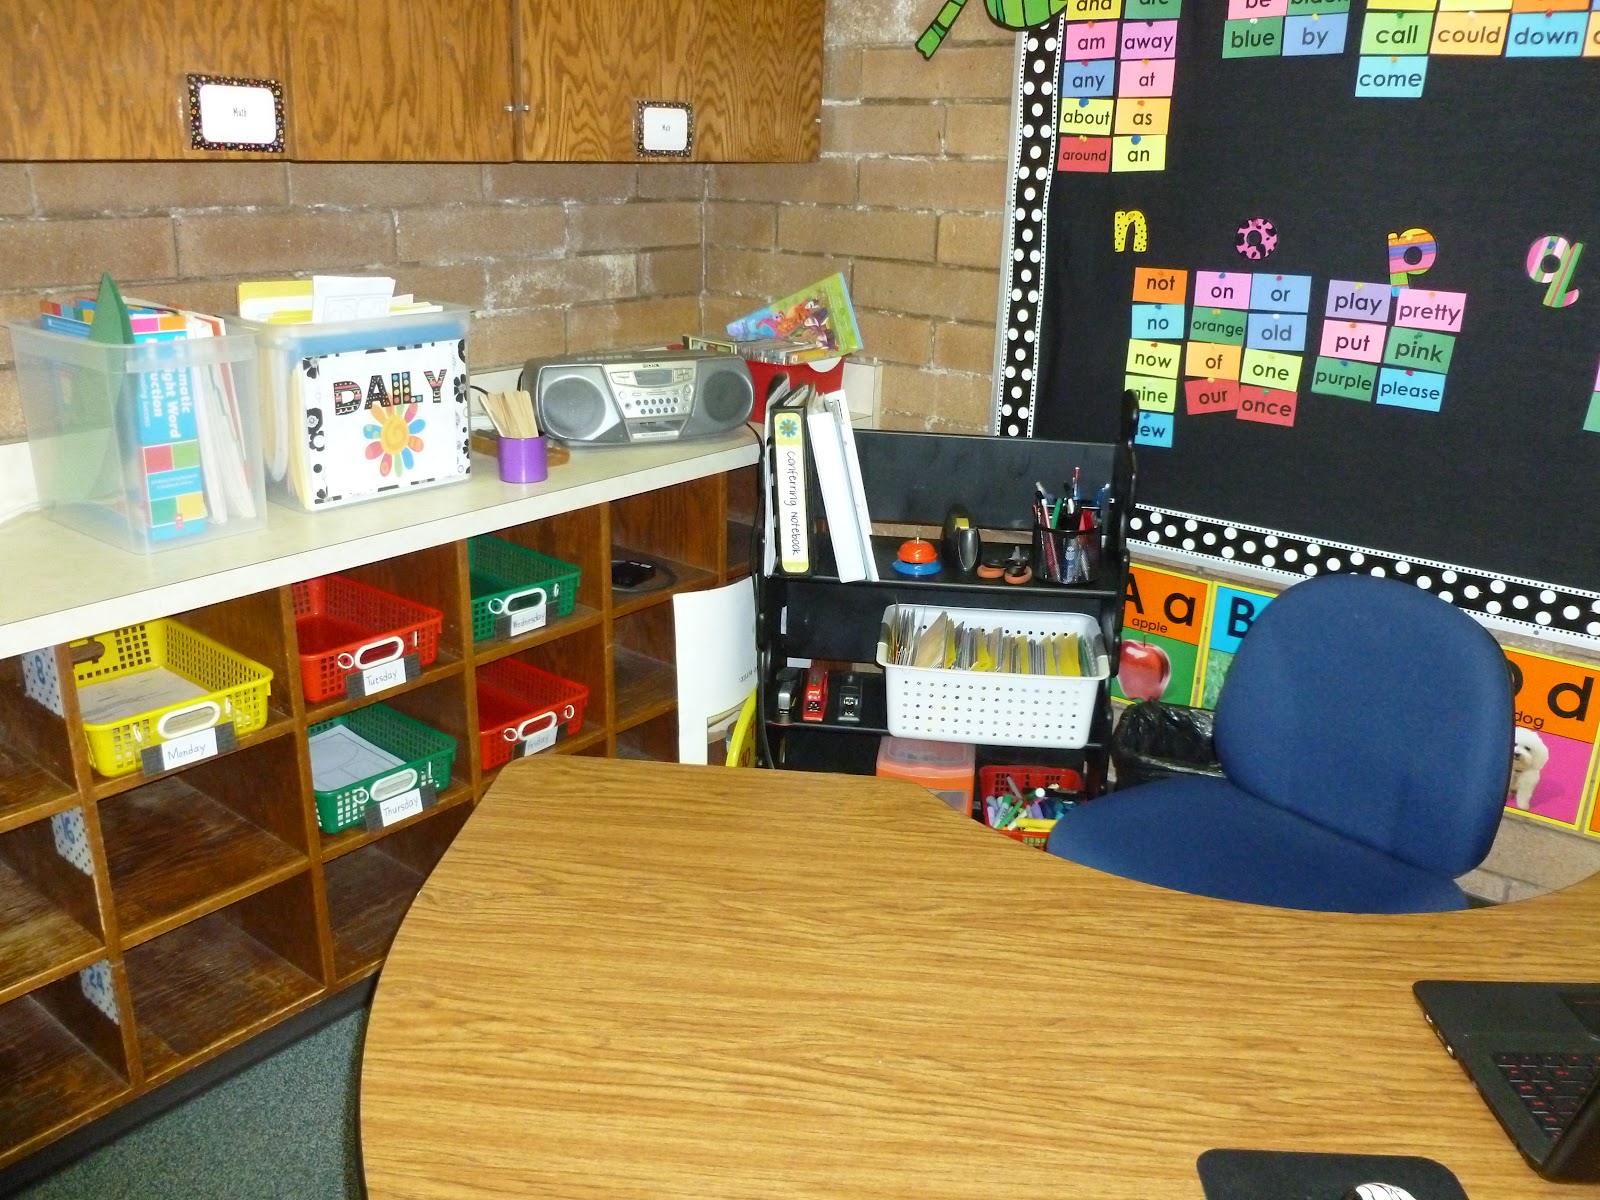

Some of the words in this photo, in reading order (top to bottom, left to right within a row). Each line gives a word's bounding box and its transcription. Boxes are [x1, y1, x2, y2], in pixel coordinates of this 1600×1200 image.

[1077, 36, 1105, 50] am
[1124, 34, 1174, 52] away
[1231, 30, 1275, 49] blue
[1301, 23, 1329, 49] by
[1375, 25, 1419, 45] call
[1437, 25, 1502, 45] could
[1514, 27, 1579, 45] down
[1072, 73, 1105, 91] any
[1139, 72, 1155, 87] at
[1358, 71, 1423, 88] come
[1063, 109, 1110, 126] about
[1132, 112, 1153, 126] as
[1062, 149, 1107, 162] around
[1127, 149, 1150, 162] an
[1114, 210, 1148, 253] n
[1387, 228, 1438, 297] p
[1526, 235, 1584, 309] q
[1146, 275, 1176, 291] not
[1210, 285, 1234, 300] on
[1270, 288, 1291, 302] or
[1334, 292, 1382, 316] play
[1399, 303, 1461, 326] pretty
[1147, 317, 1169, 331] no
[1192, 319, 1245, 337] orange
[1261, 325, 1292, 341] old
[1335, 334, 1370, 352] put
[1395, 340, 1444, 364] pink
[1135, 352, 1172, 369] now
[1205, 354, 1224, 370] of
[161, 363, 177, 398] ight
[1252, 363, 1289, 381] one
[1314, 371, 1372, 391] purple
[333, 369, 447, 416] DAILY
[1198, 388, 1228, 405] our
[1380, 381, 1440, 400] please
[1241, 399, 1293, 417] once
[167, 401, 182, 439] Word
[1138, 425, 1166, 438] ew
[1163, 592, 1196, 627] a
[1226, 596, 1255, 639] B
[512, 612, 545, 628] Wednesday
[1131, 617, 1168, 634] apple
[35, 654, 46, 685] 8
[365, 670, 397, 686] Tuesday
[1547, 676, 1595, 722] d
[1514, 710, 1545, 729] dog
[167, 744, 206, 760] Monday
[383, 796, 418, 816] Thursday
